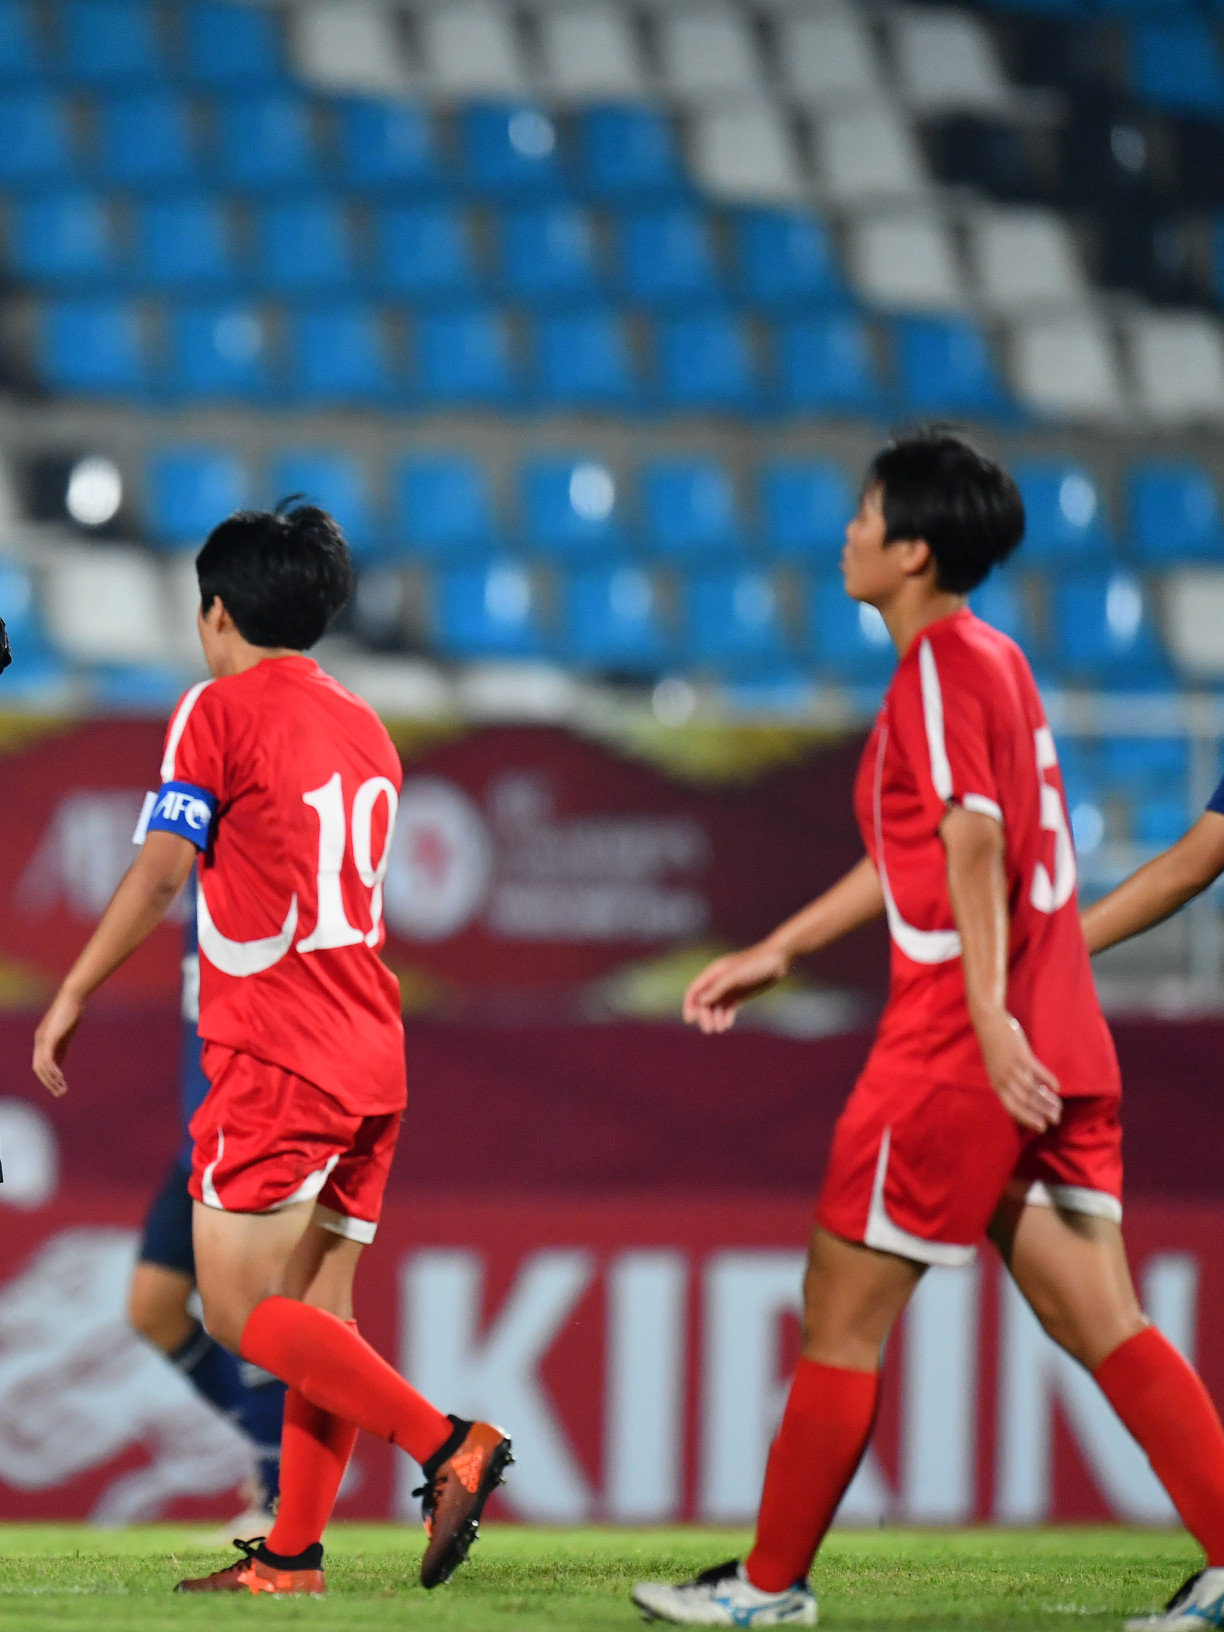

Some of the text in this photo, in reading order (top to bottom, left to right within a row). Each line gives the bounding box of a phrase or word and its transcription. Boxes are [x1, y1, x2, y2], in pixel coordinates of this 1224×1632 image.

[153, 791, 211, 830] AFC
[296, 772, 398, 953] 19
[1032, 725, 1075, 914] 5
